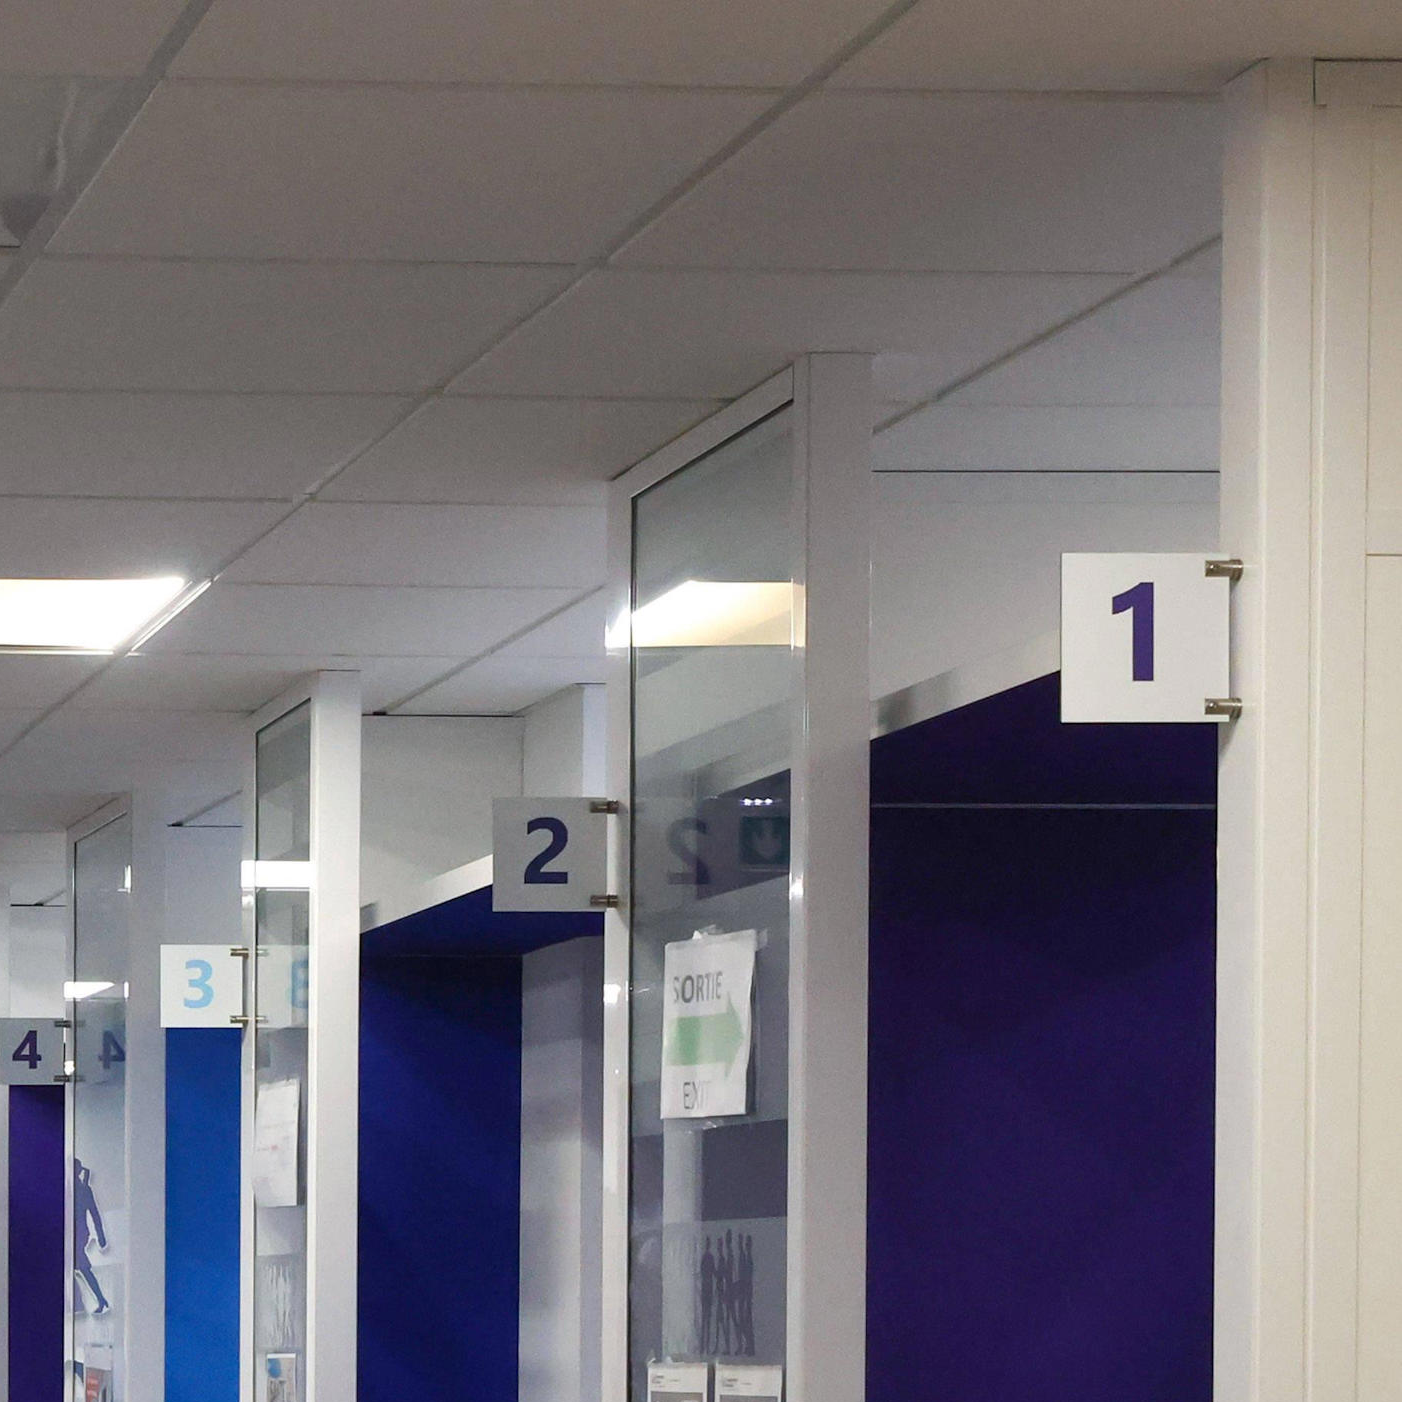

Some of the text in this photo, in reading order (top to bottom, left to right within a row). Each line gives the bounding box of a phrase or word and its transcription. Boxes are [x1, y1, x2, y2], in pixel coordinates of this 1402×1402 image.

[1112, 582, 1154, 681] 1
[523, 816, 569, 885] 2
[183, 959, 215, 1009] 3
[673, 970, 723, 1004] SORTIE
[11, 1029, 42, 1070] 4
